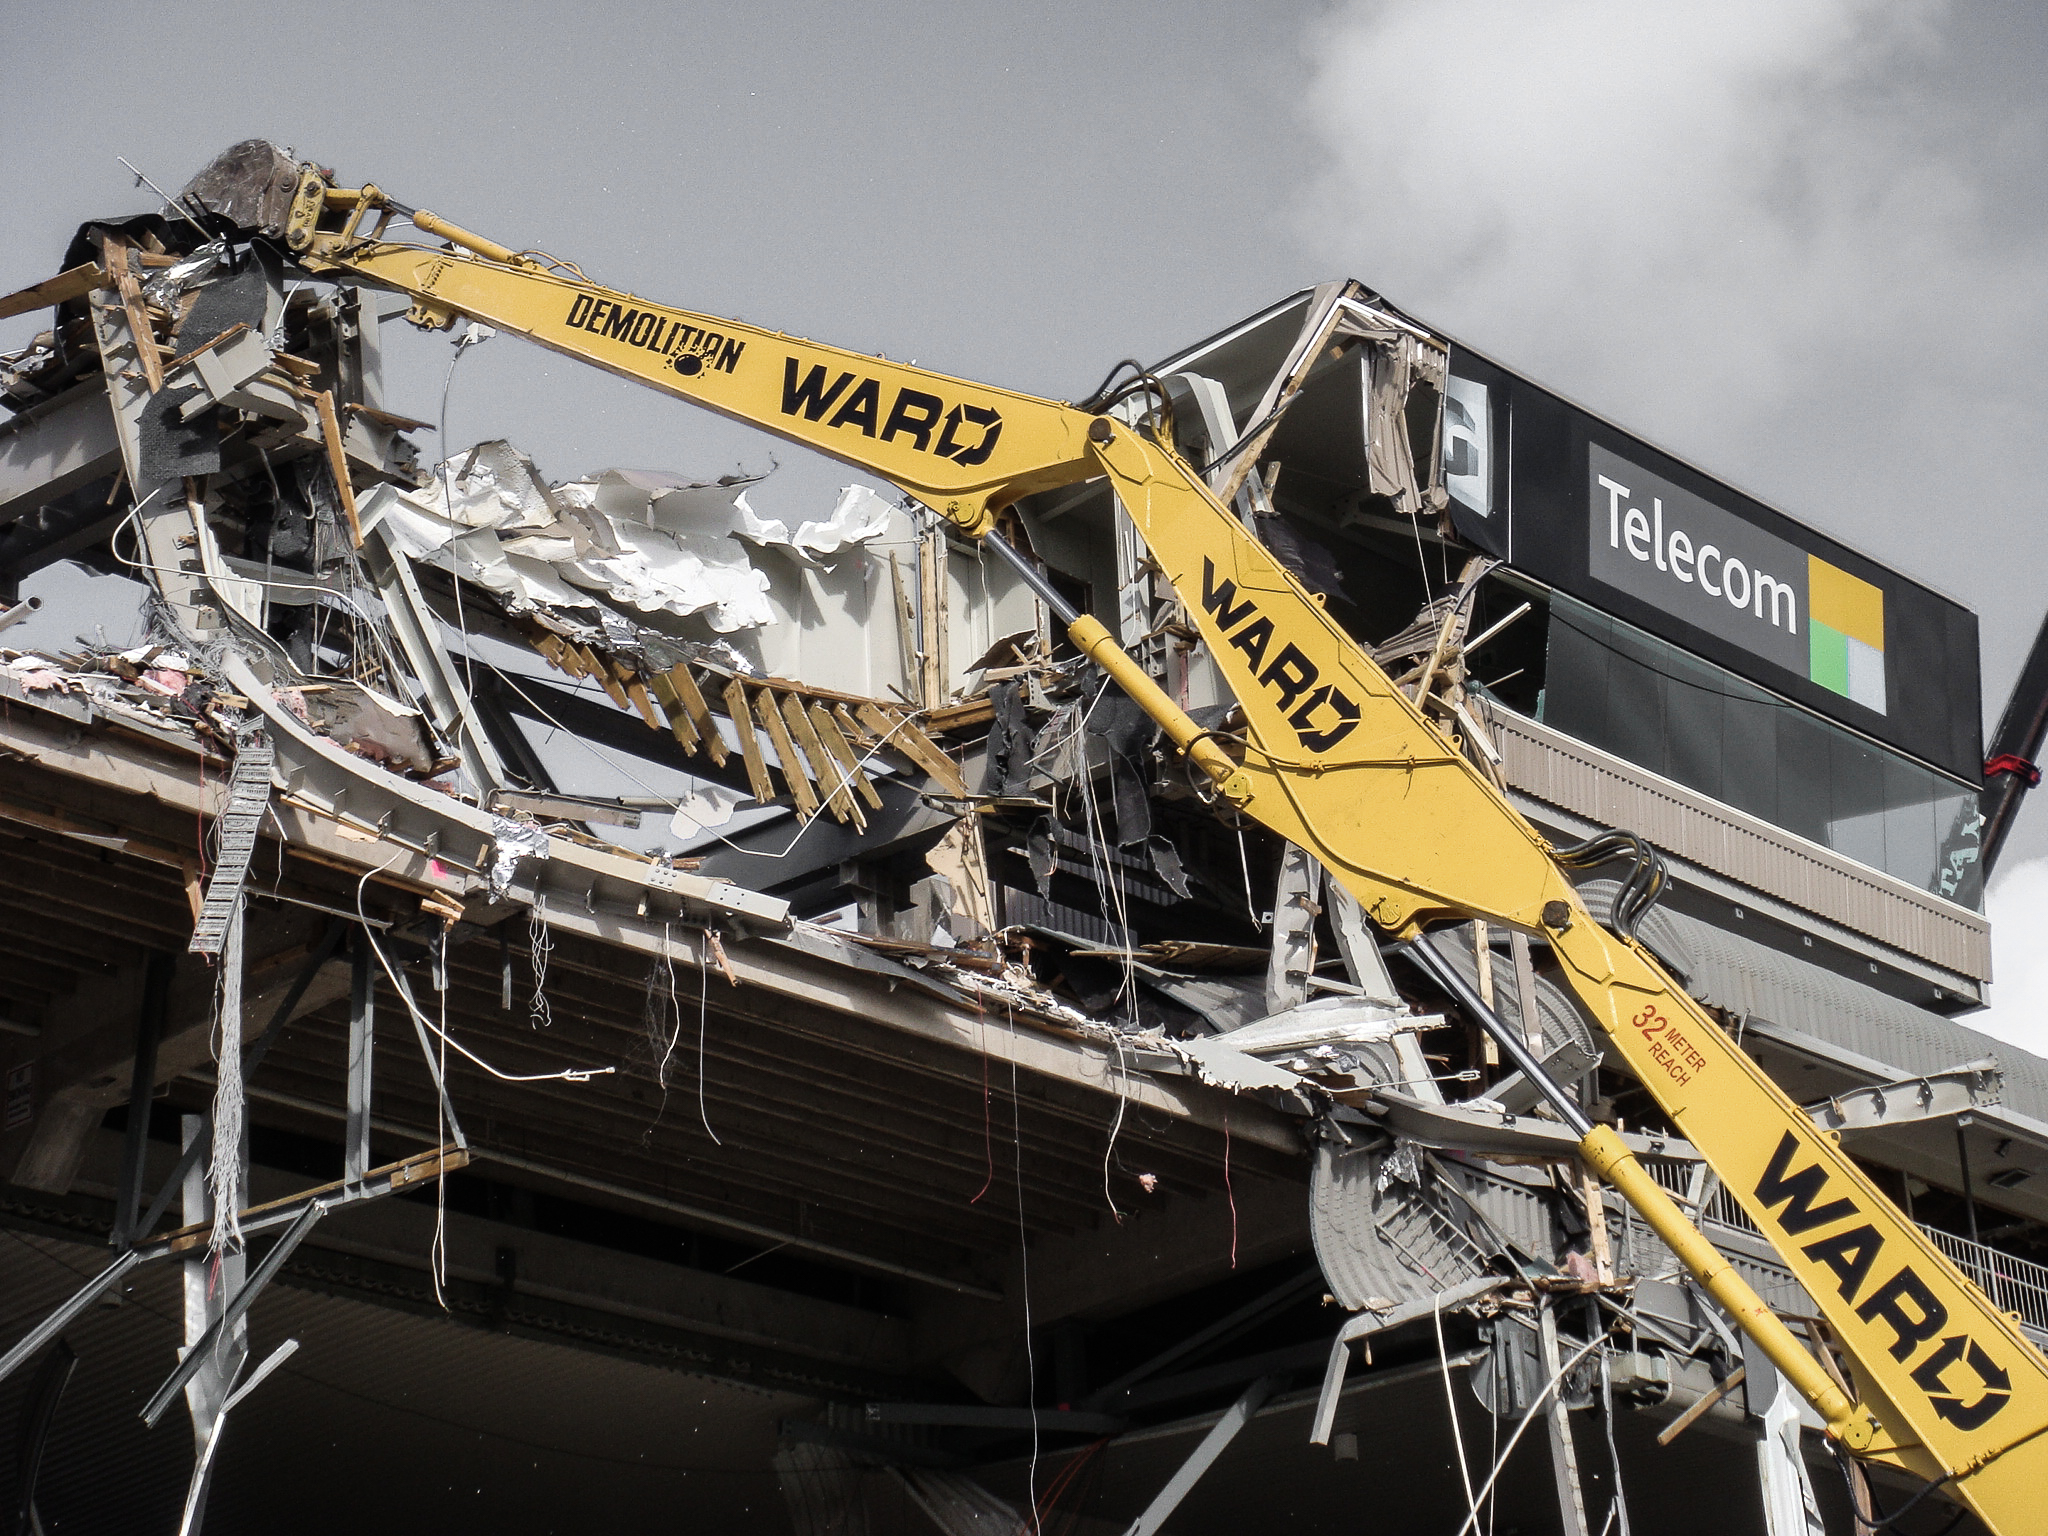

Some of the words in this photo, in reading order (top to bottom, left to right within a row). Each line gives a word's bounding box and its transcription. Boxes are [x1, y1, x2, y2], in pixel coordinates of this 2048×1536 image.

[565, 293, 746, 374] DEMOLITION
[780, 356, 1003, 467] WARD
[1598, 474, 1797, 635] Telecom
[1201, 554, 1361, 753] WARD
[1632, 1004, 1668, 1042] 32
[1664, 1027, 1707, 1073] METER
[1648, 1041, 1692, 1088] REACH
[1753, 1128, 2012, 1432] WARD
